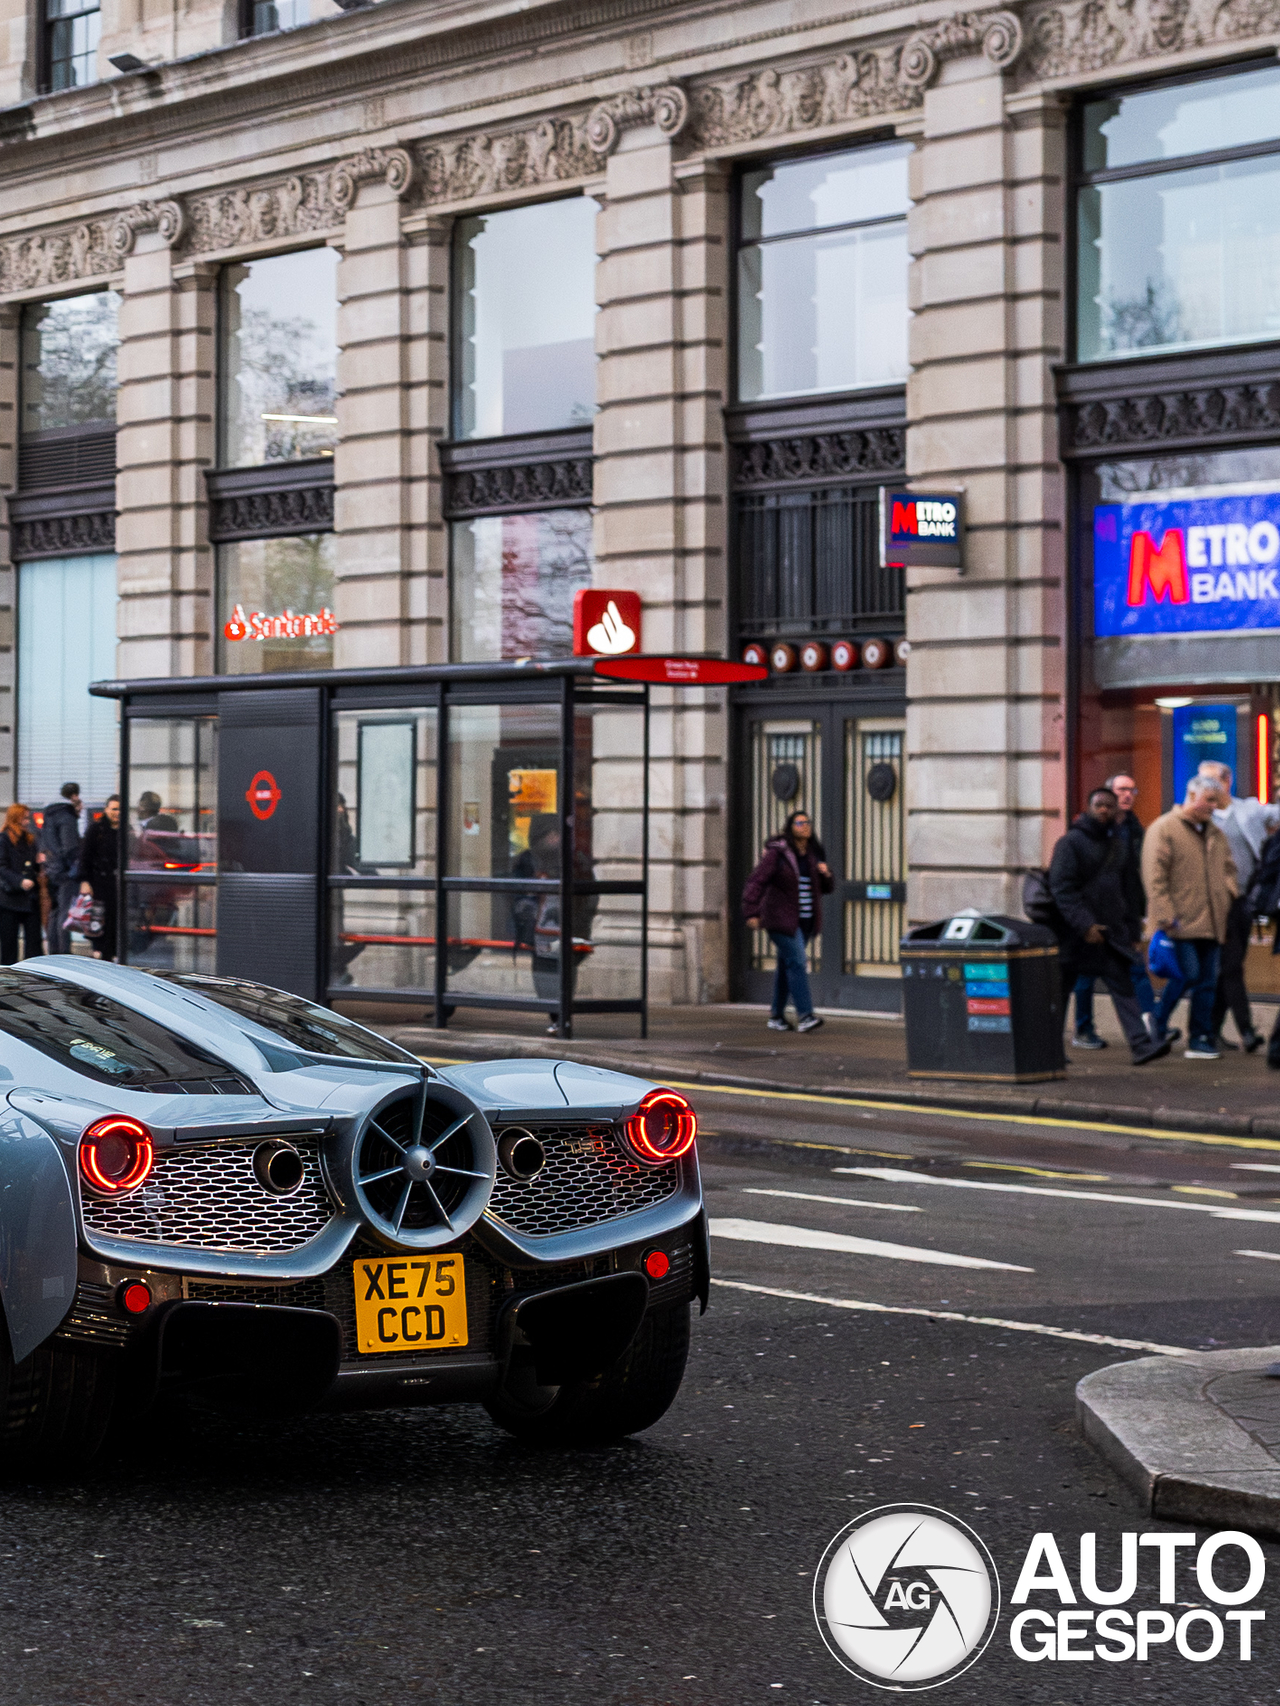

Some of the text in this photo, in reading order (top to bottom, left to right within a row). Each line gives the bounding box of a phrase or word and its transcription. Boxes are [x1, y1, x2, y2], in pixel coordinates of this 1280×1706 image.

[891, 501, 956, 535] METRO
[918, 521, 956, 537] BANK
[1127, 520, 1280, 607] METRO
[1192, 568, 1280, 604] BANK
[249, 607, 340, 640] Santande
[363, 1260, 455, 1301] XE75
[377, 1304, 446, 1343] CCD
